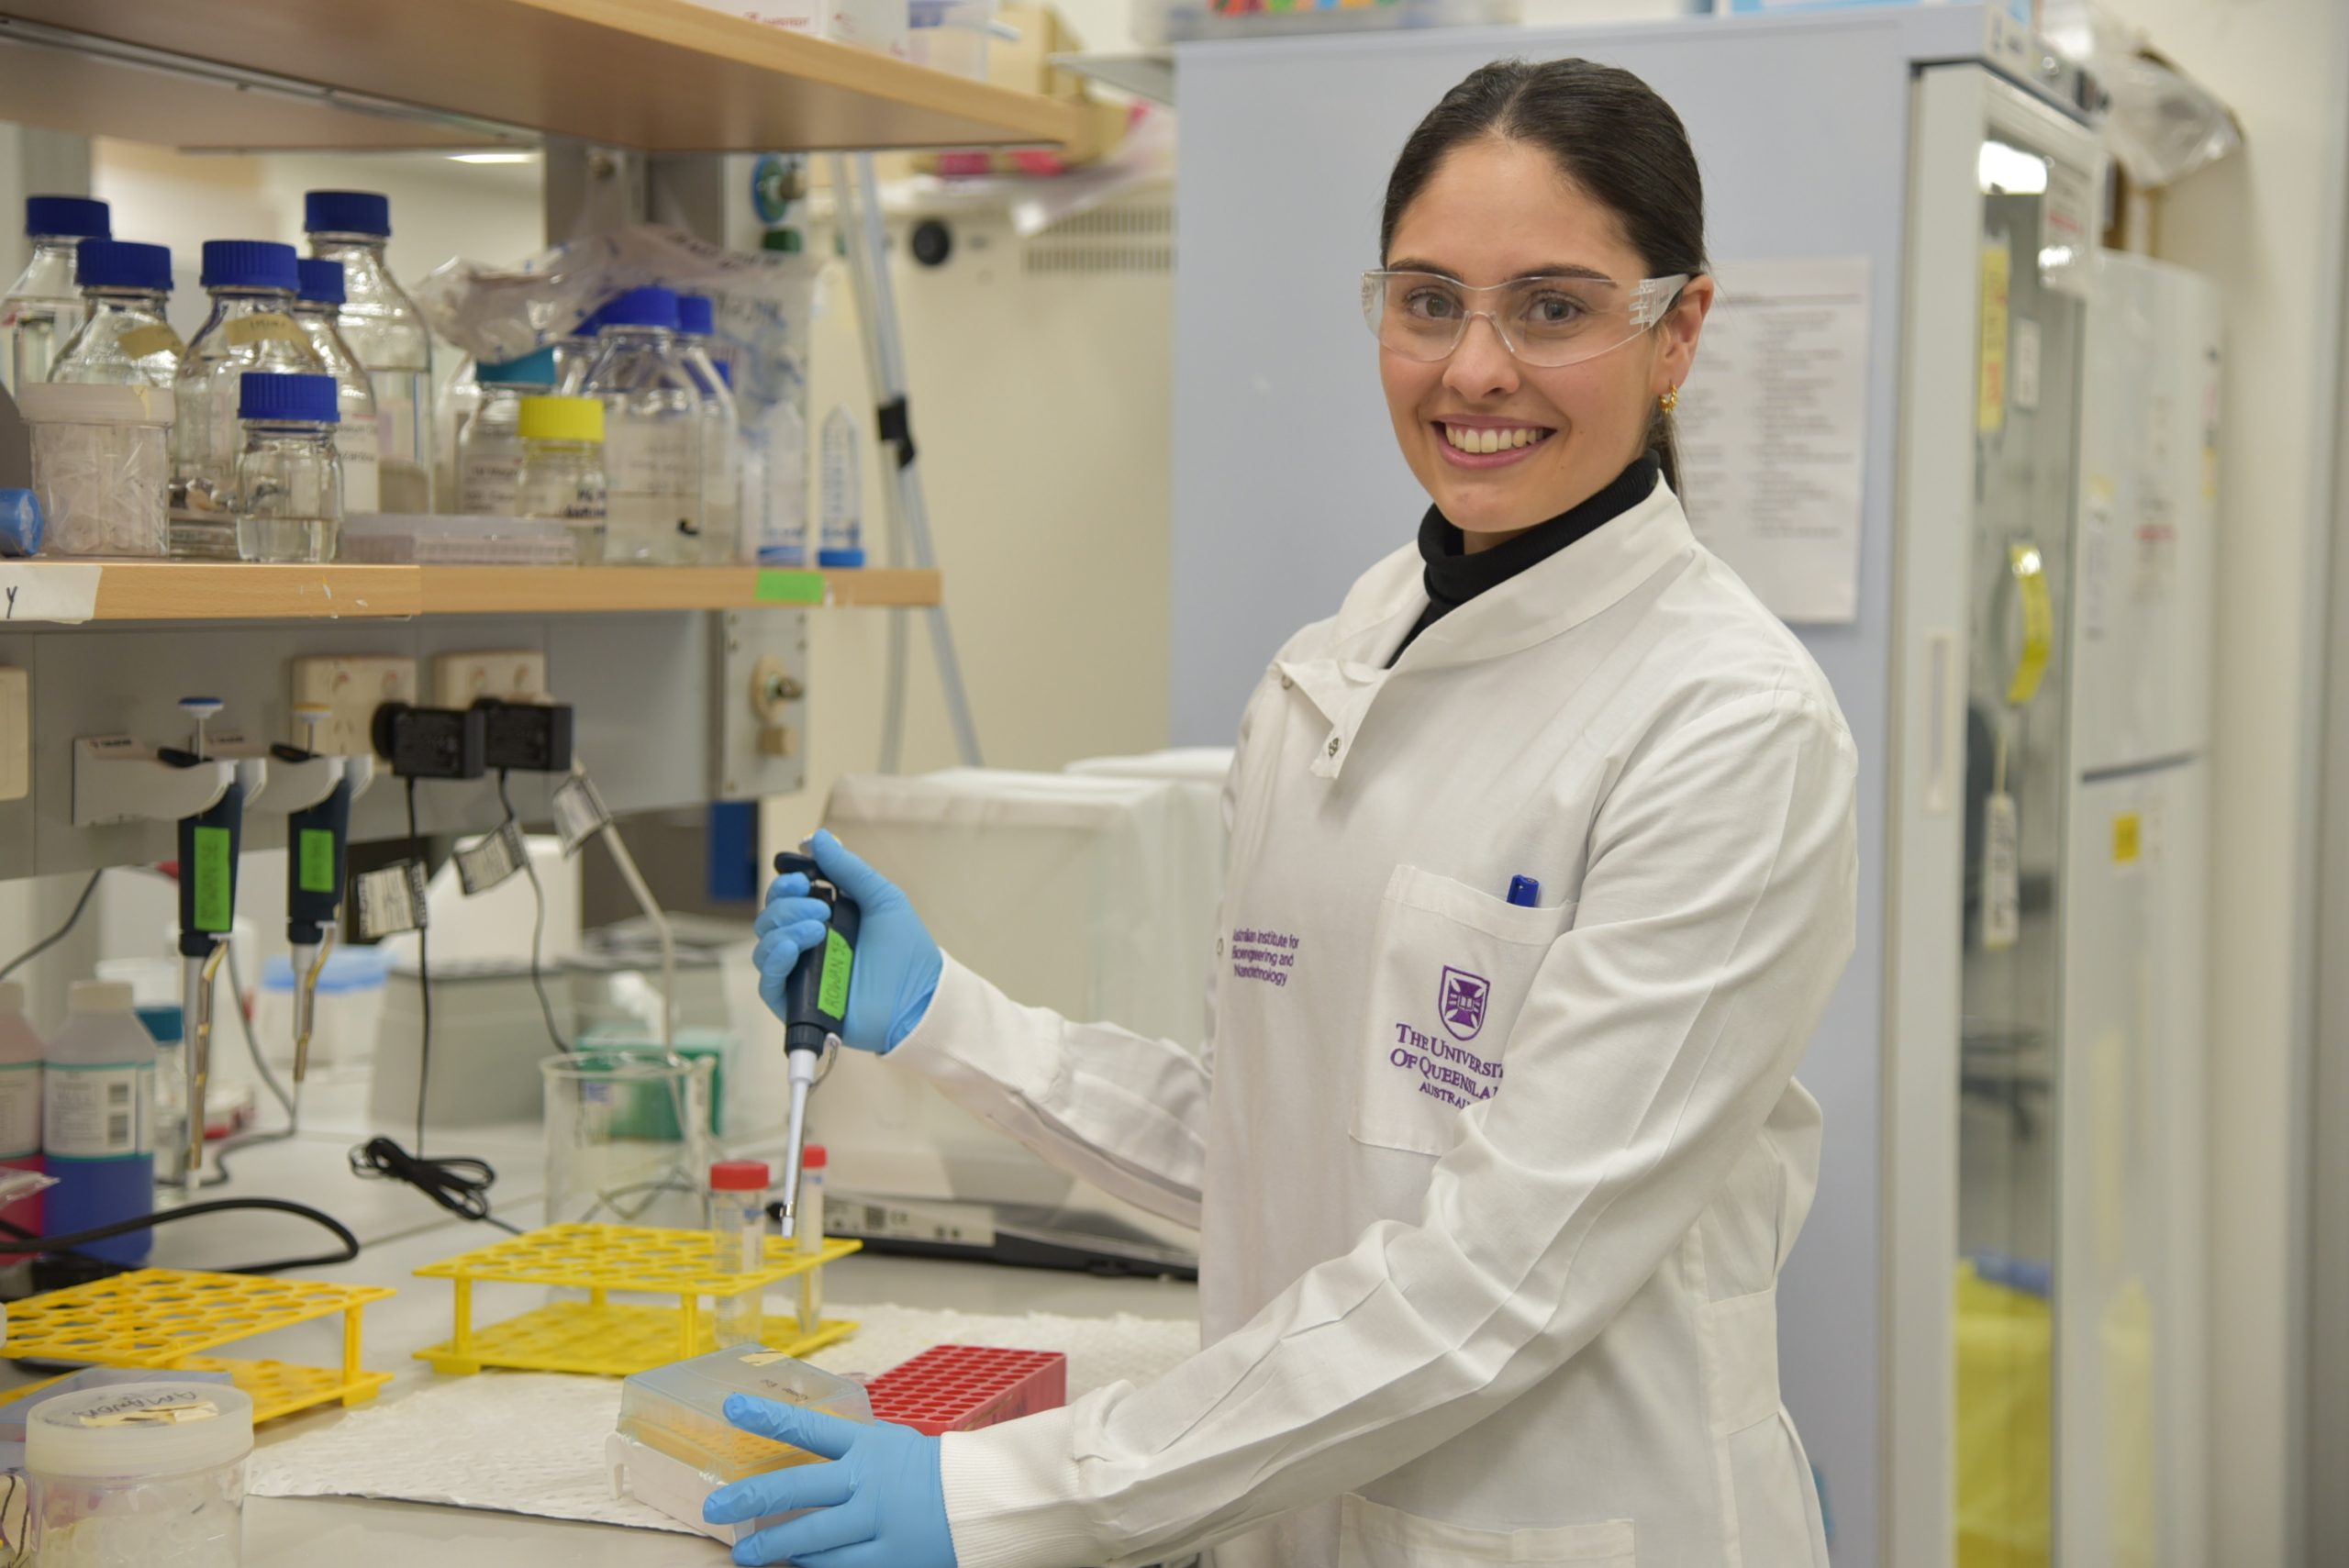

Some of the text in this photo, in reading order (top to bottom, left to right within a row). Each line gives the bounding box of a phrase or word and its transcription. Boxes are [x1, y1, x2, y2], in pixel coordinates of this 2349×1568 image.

[6, 585, 17, 620] Y
[1257, 929, 1287, 948] Institute
[1289, 933, 1299, 950] for
[1231, 944, 1294, 967] Bioengeering and
[1233, 963, 1287, 987] Nanothnology
[1396, 1022, 1503, 1079] THE UNIVERSIT
[1390, 1048, 1498, 1100] OF QUEENSLA
[1419, 1082, 1471, 1109] AUSTRAL
